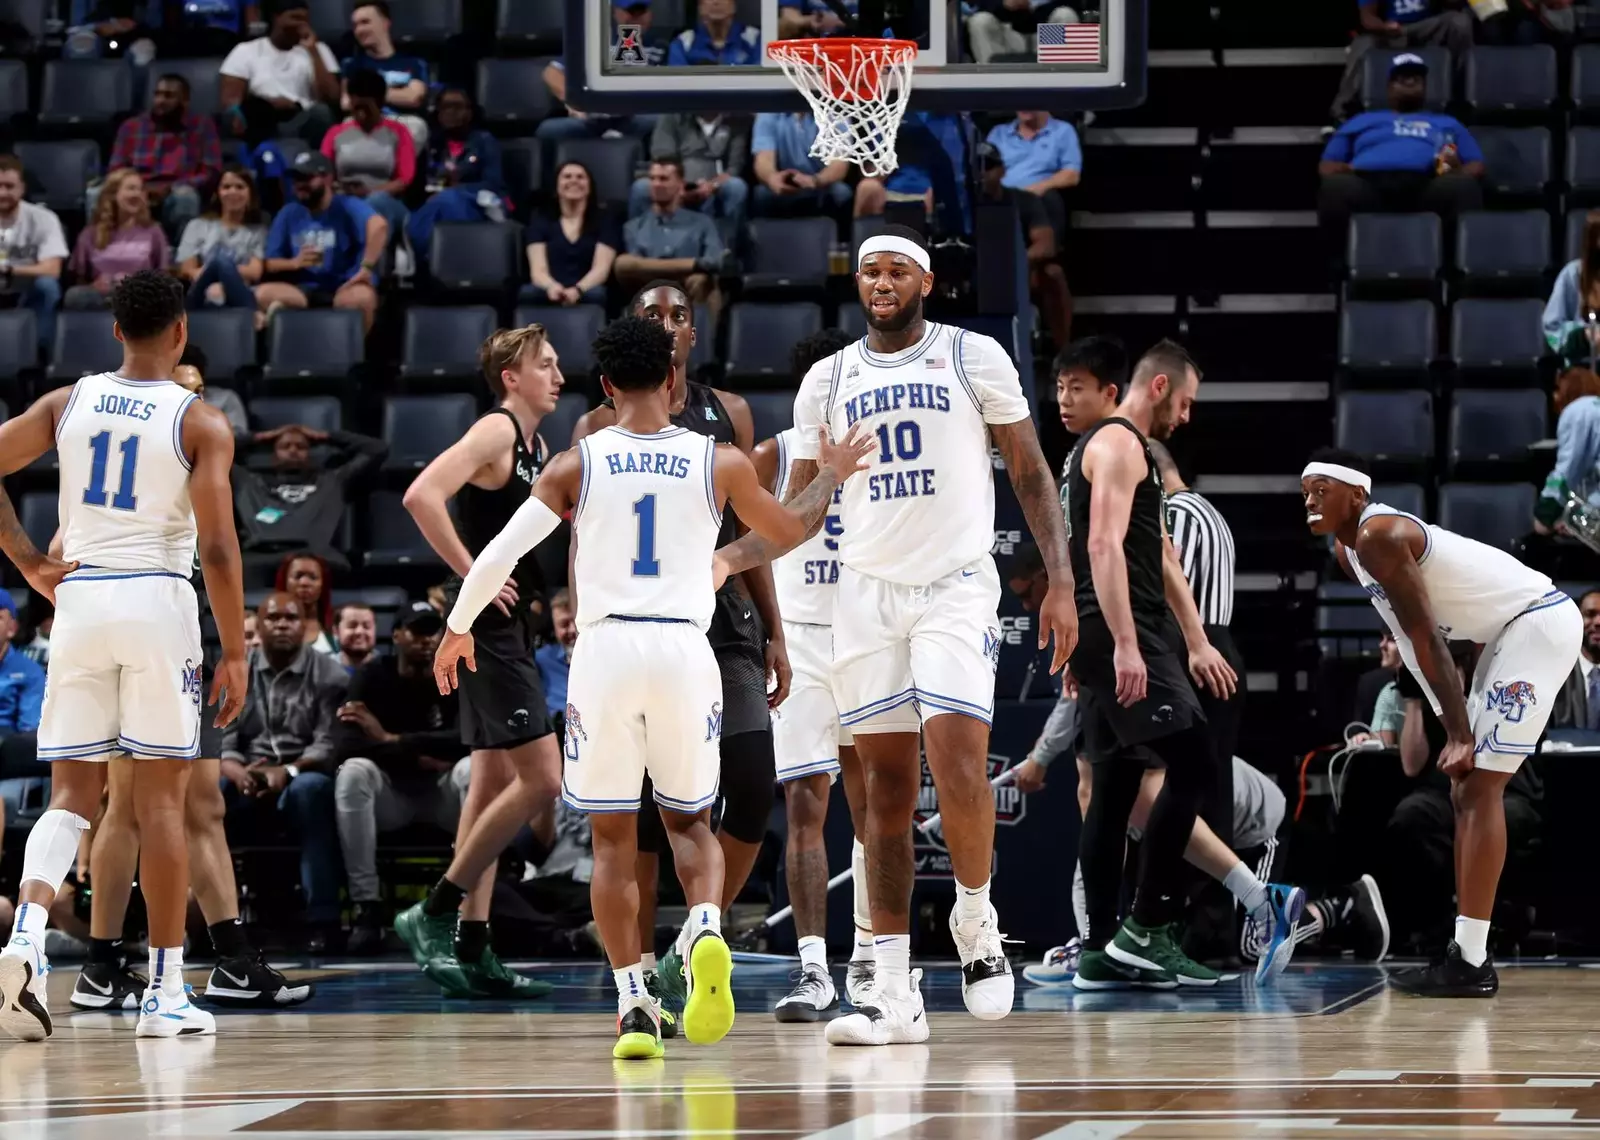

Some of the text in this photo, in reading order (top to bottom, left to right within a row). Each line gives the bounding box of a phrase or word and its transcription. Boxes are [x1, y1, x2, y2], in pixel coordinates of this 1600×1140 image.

[94, 394, 157, 421] JONES
[844, 383, 951, 428] MEMPHIS
[875, 420, 923, 464] 10
[82, 428, 141, 512] 11
[605, 452, 691, 479] HARRIS
[868, 469, 935, 502] STATE
[631, 493, 661, 578] 1
